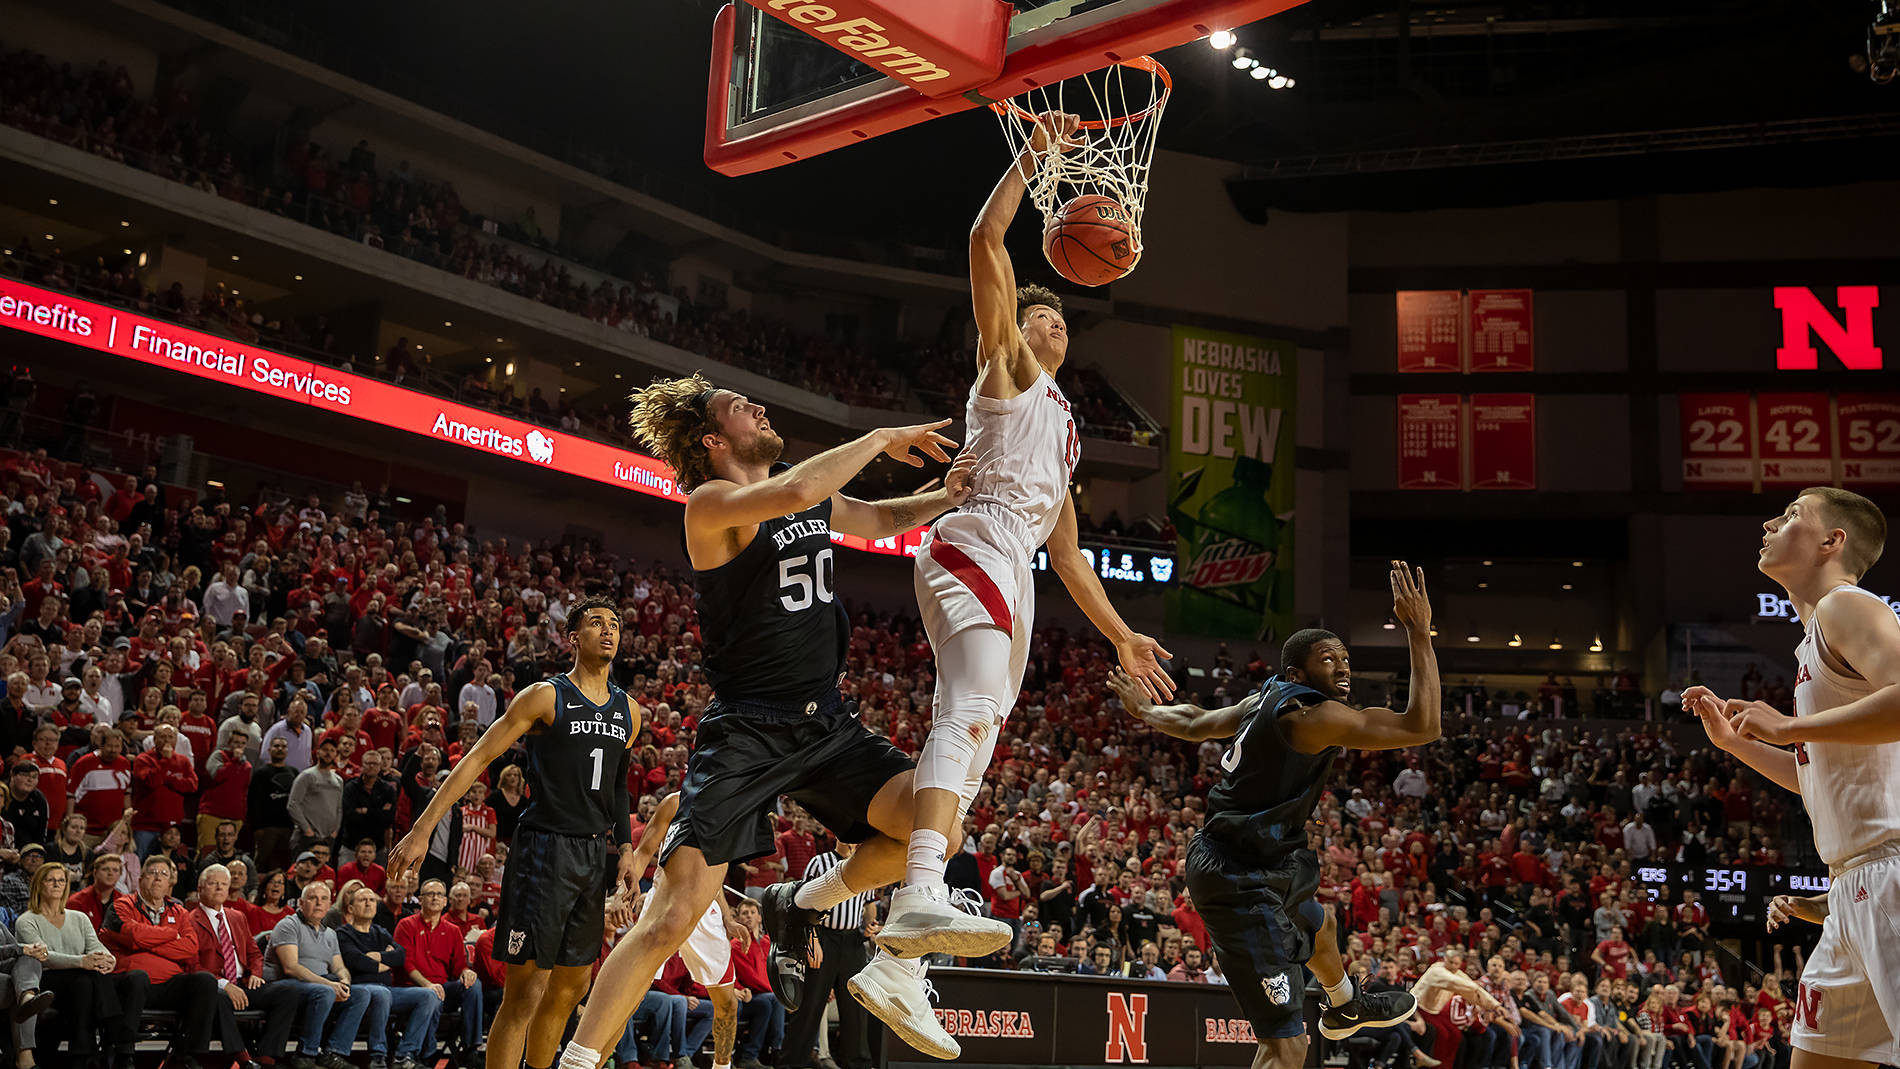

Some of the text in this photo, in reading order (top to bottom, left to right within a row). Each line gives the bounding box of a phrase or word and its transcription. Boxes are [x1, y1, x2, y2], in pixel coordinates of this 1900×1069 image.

[1773, 285, 1883, 370] N
[132, 325, 245, 377] Financial
[251, 358, 351, 405] Services
[1183, 337, 1282, 376] NEBRASKA
[1183, 366, 1243, 399] LOVES
[431, 412, 523, 456] Ameritas
[1182, 395, 1282, 464] DEW
[1689, 419, 1745, 452] 22
[1765, 419, 1821, 452] 42
[1848, 419, 1900, 452] 52
[613, 461, 673, 496] fulfilling
[1686, 463, 1702, 477] N
[1764, 463, 1780, 477] N
[772, 518, 831, 551] BUTLER
[1108, 567, 1145, 582] FOULS
[1120, 553, 1134, 571] 5
[778, 548, 834, 612] 50
[569, 720, 627, 743] BUTLER
[589, 747, 604, 791] 1
[1705, 869, 1747, 891] 35.9
[1789, 875, 1830, 892] BULLD
[932, 1008, 1035, 1038] EBRASKA
[1105, 992, 1149, 1063] N
